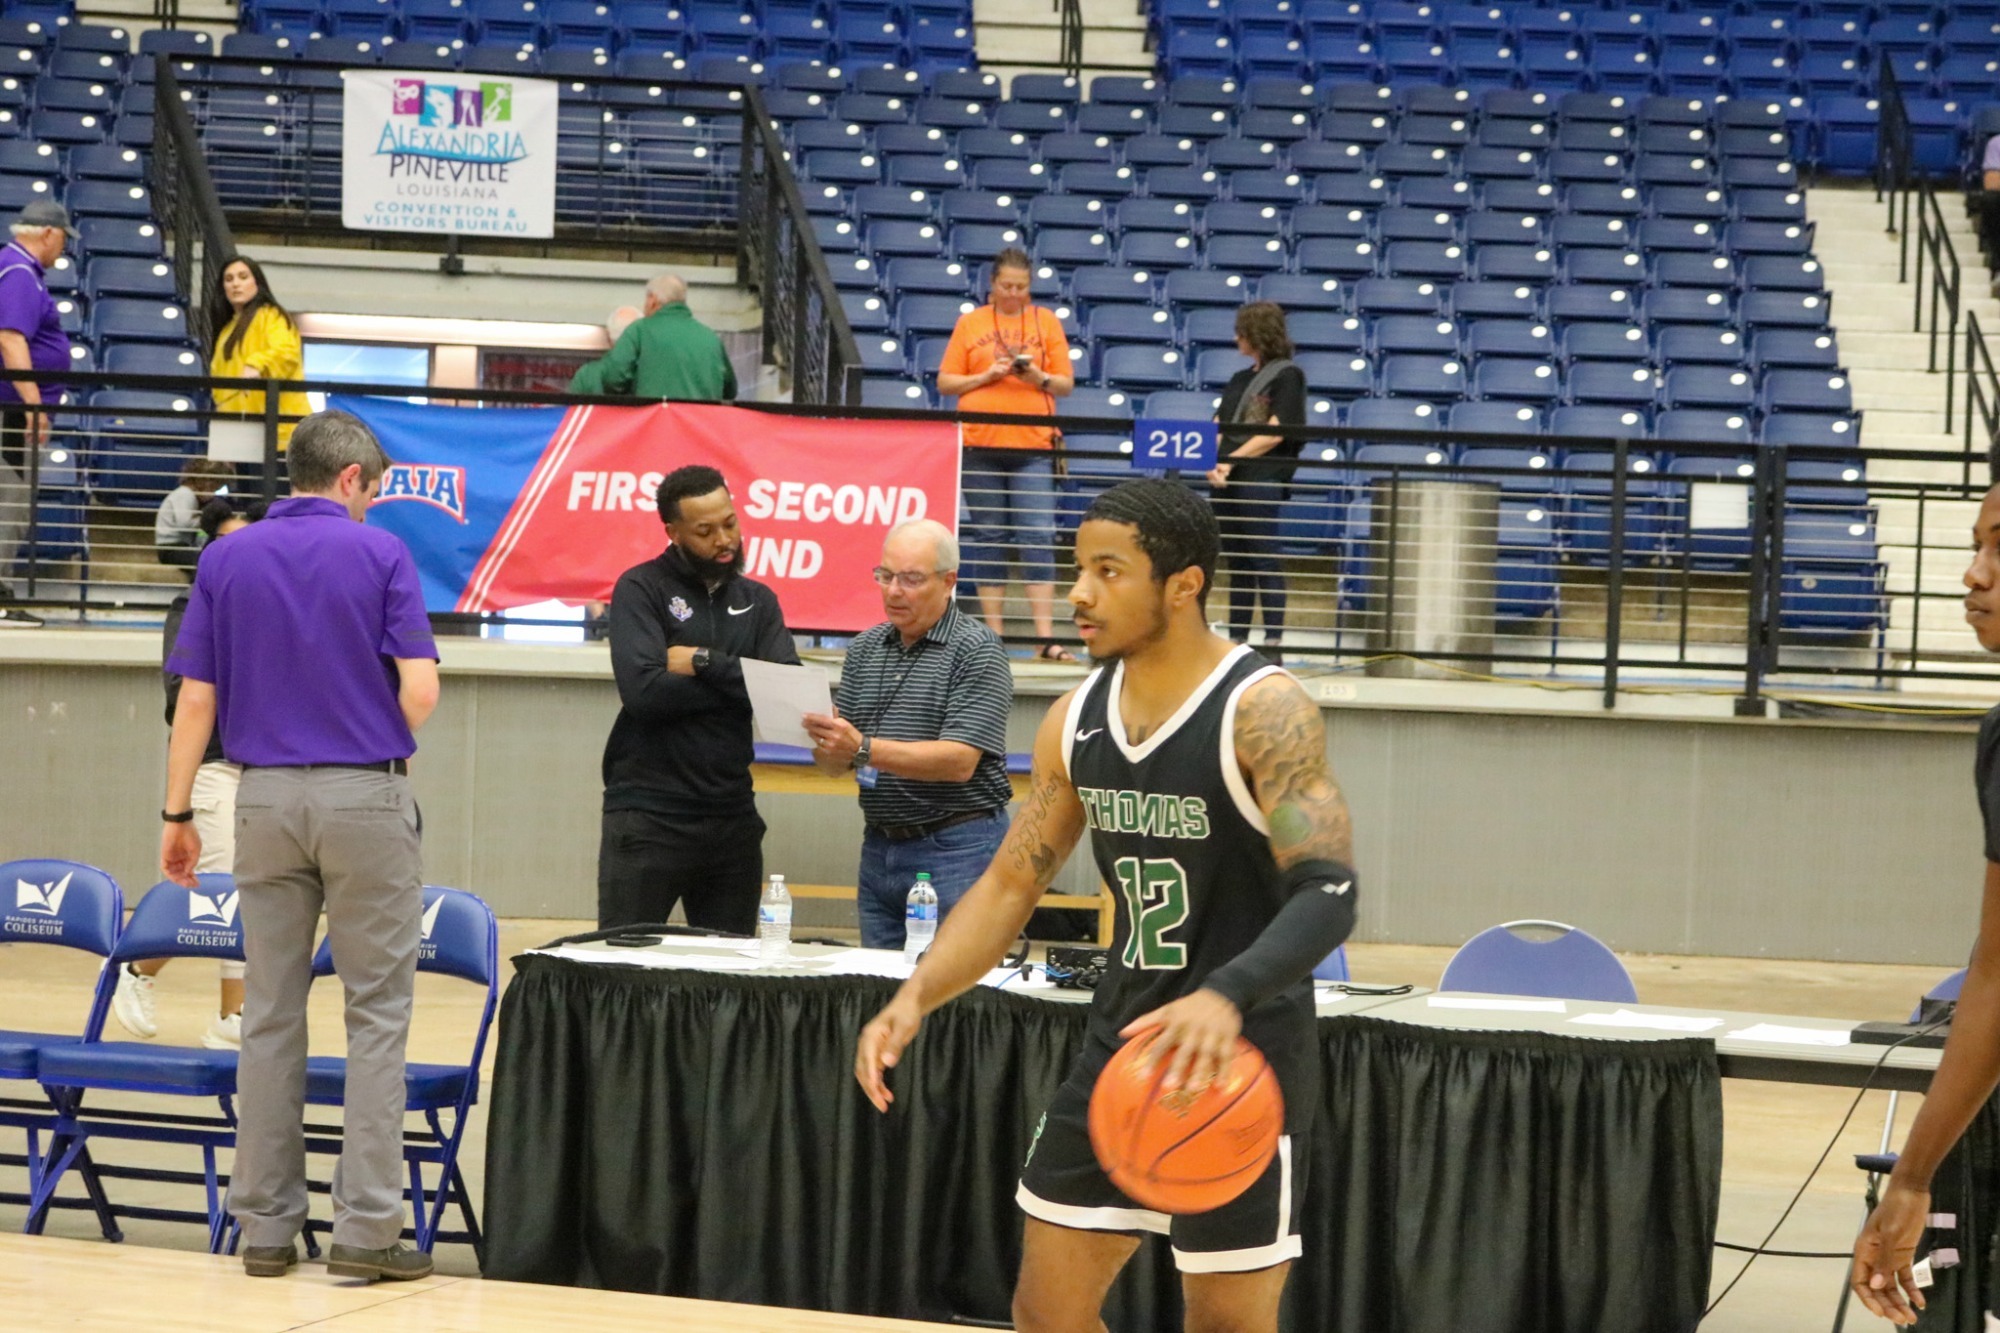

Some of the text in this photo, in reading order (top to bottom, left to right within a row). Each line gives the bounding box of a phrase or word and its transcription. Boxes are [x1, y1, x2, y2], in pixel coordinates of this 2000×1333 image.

[377, 120, 527, 161] ALEXANDRIA
[389, 154, 509, 183] PINEVILLE
[397, 184, 499, 199] LOUISIANA
[364, 214, 527, 232] VISITORS BUREAU
[374, 201, 518, 219] CONVENTION &
[1148, 430, 1203, 459] 212
[383, 466, 462, 515] AIA
[567, 471, 665, 511] FIRS
[743, 478, 928, 526] SECOND
[740, 536, 824, 579] UND
[1078, 787, 1211, 839] THOMAS
[5, 916, 64, 926] RAPIDES PARISH
[1114, 857, 1190, 970] 12
[4, 922, 63, 936] COLISEUM
[177, 934, 237, 947] COLISEUM
[178, 928, 211, 936] RAPIDES
